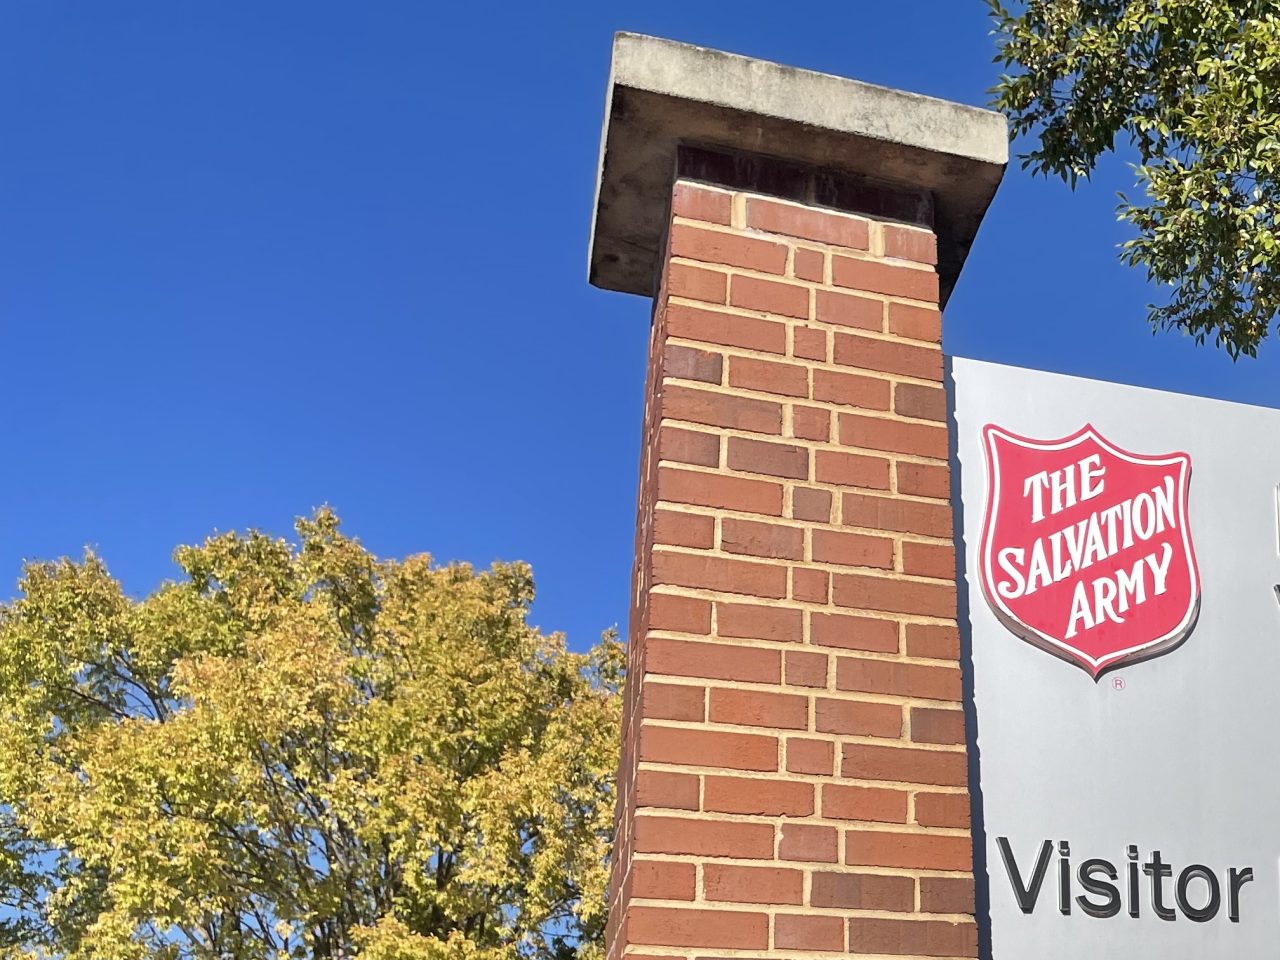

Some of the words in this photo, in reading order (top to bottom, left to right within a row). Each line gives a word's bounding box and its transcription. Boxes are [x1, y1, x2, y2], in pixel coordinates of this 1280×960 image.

[1023, 453, 1106, 524] THE
[997, 475, 1175, 599] SALVATION
[1064, 542, 1173, 639] ARMY
[995, 836, 1254, 923] Visitor
